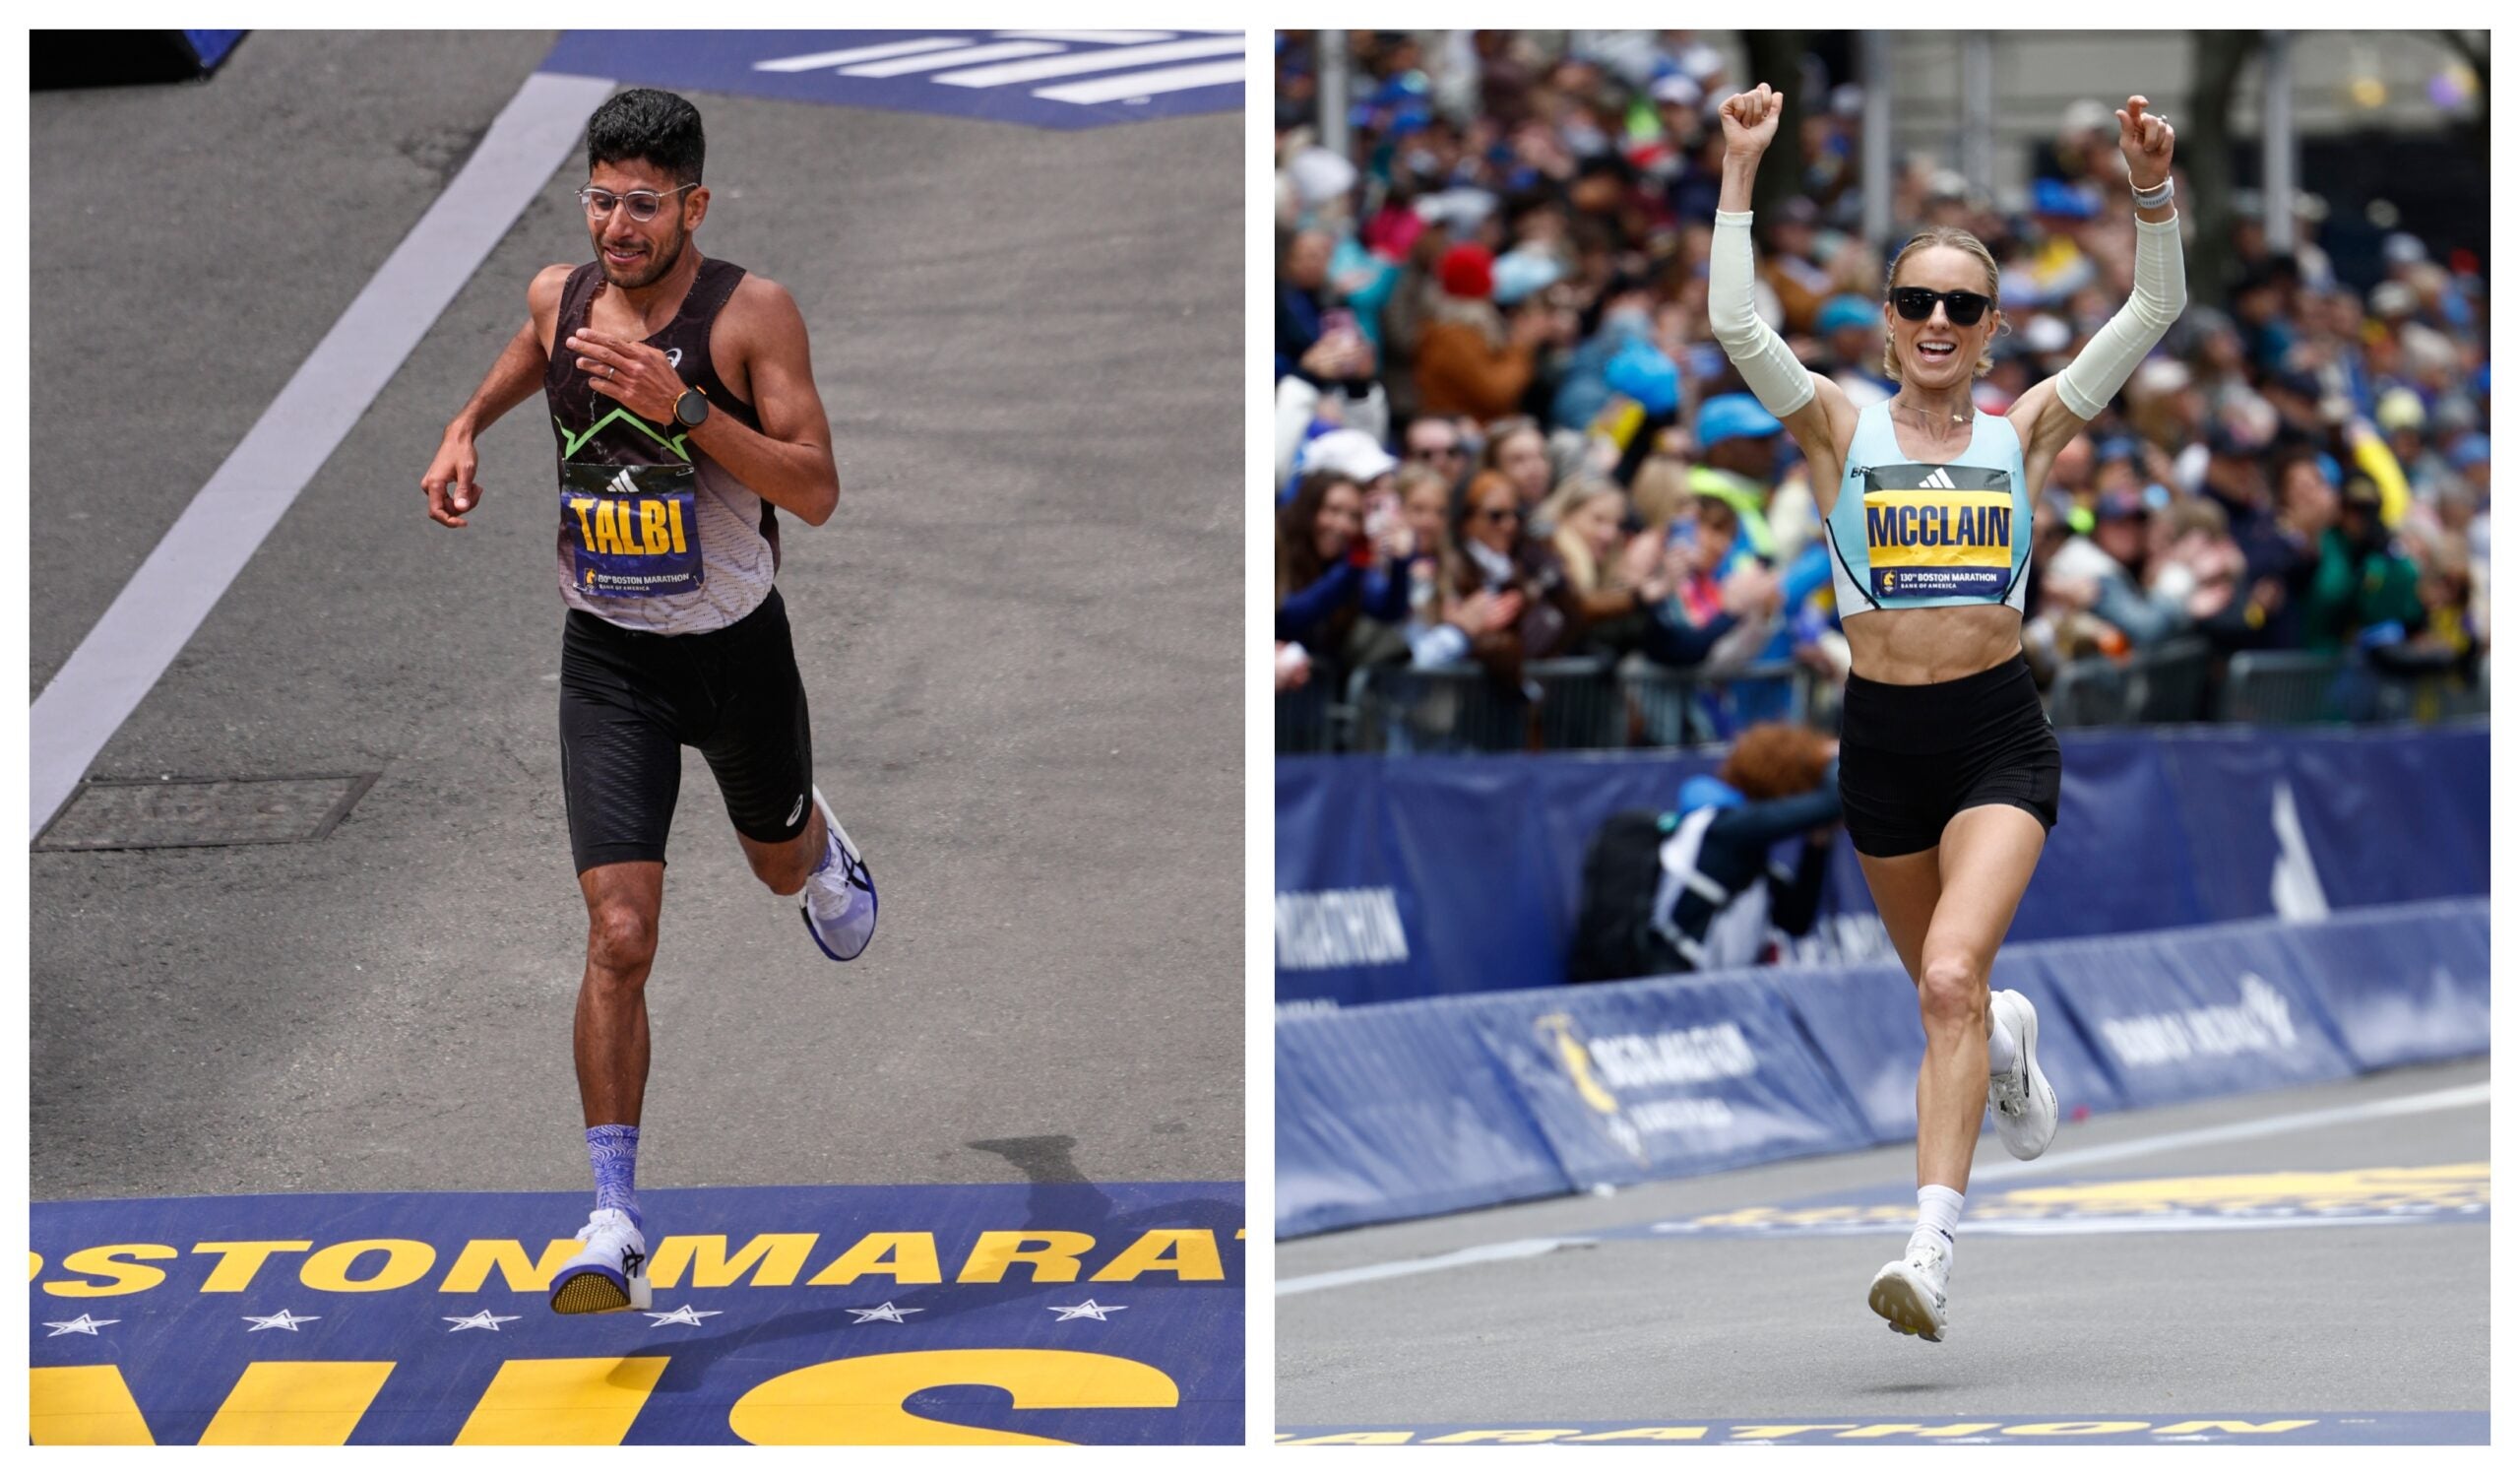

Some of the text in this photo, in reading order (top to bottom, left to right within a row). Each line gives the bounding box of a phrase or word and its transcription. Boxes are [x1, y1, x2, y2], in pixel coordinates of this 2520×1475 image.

[569, 498, 687, 555] TALBI
[1866, 505, 2010, 547] MCCLAIN
[612, 576, 643, 585] BOSTON
[643, 573, 689, 584] MARATHON
[1918, 573, 1949, 582] BOSTON
[1951, 573, 1997, 582] MARATHON
[30, 1228, 1246, 1298] STON MARA
[1275, 1419, 2319, 1445] ARATHON
